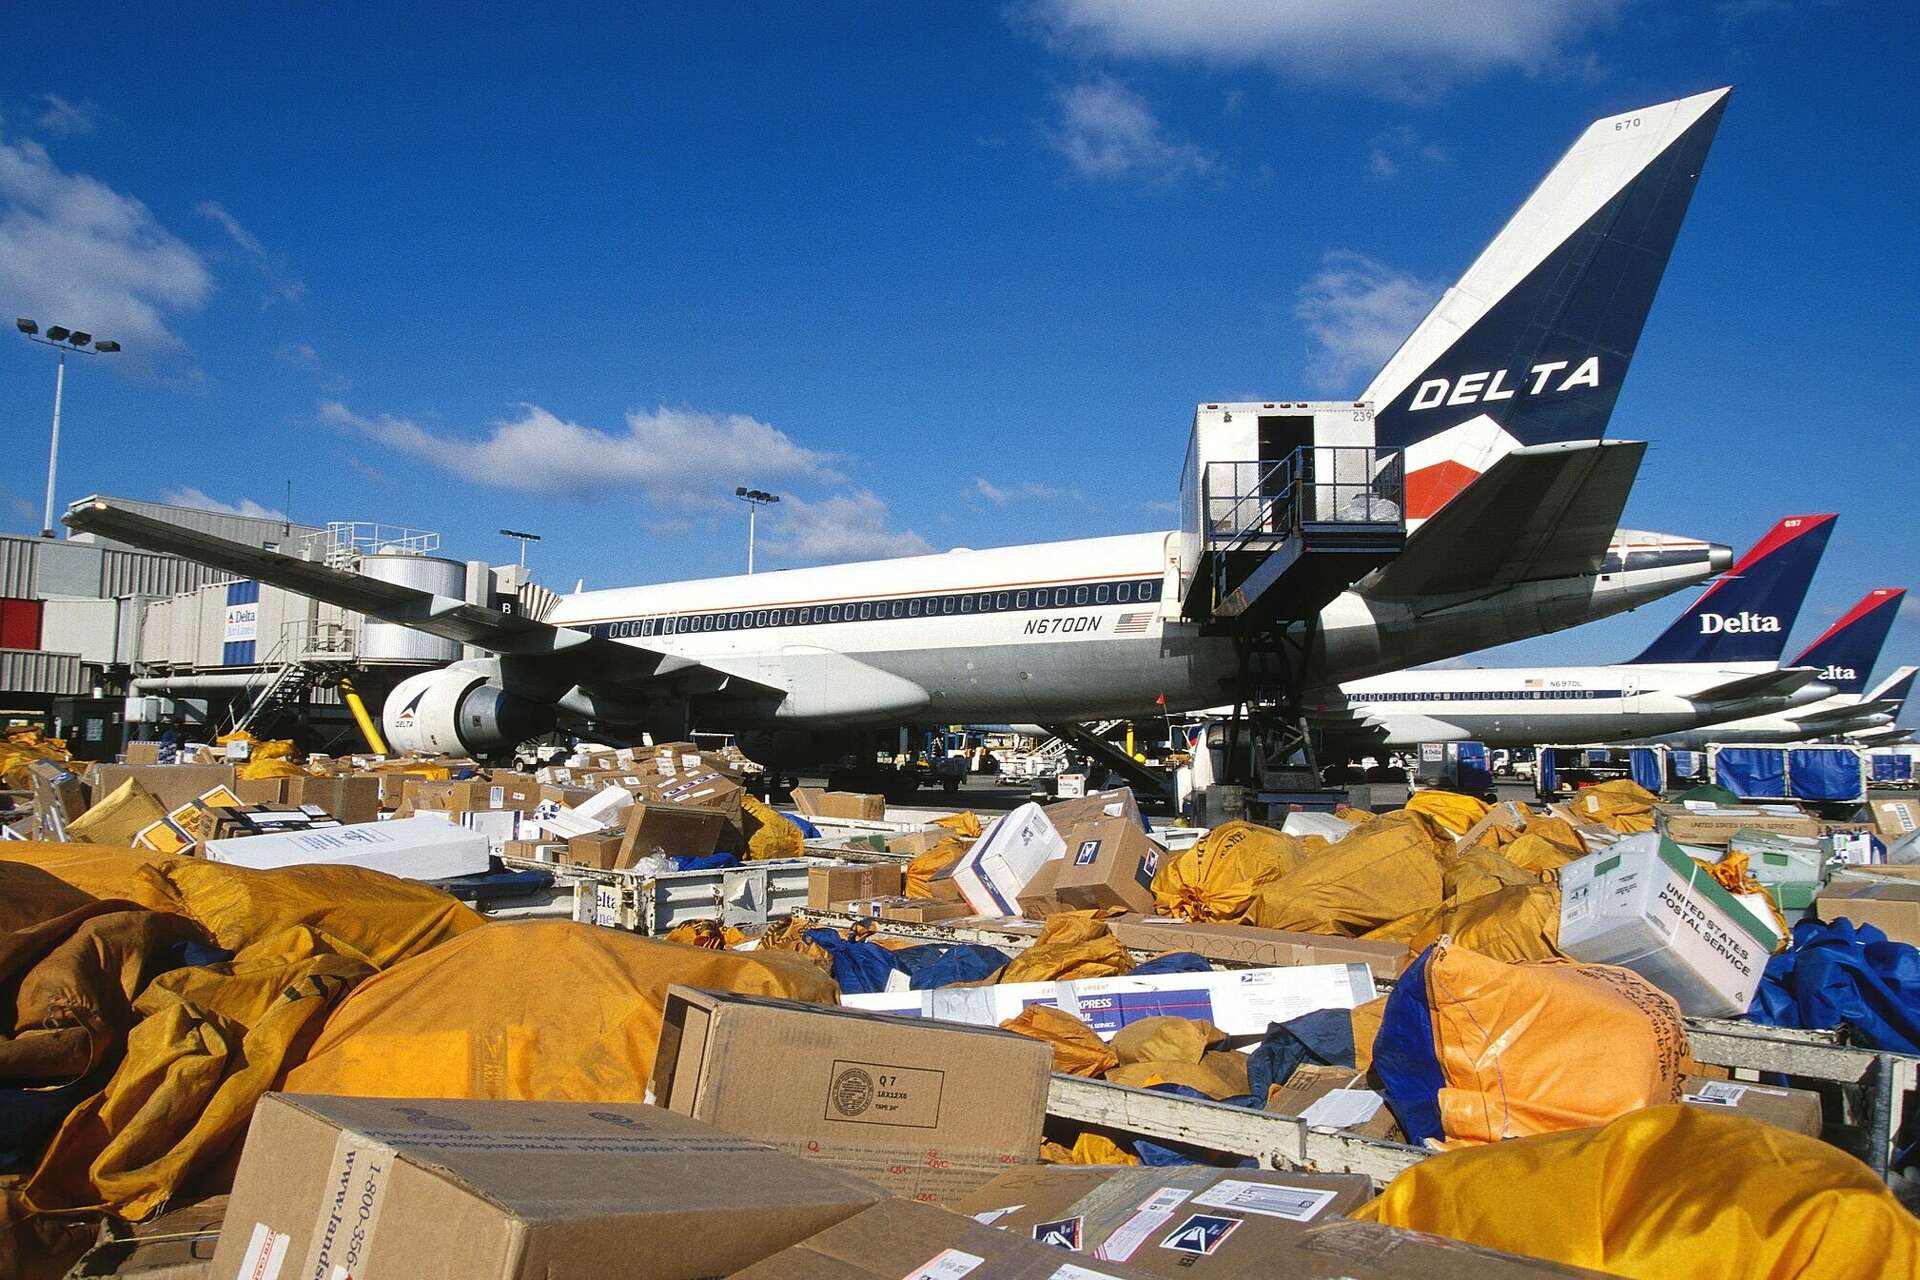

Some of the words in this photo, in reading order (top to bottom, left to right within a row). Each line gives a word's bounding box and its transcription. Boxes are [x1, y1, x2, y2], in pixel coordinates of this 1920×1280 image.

[1615, 118, 1641, 131] 670
[1408, 356, 1599, 412] DELTA
[1353, 411, 1372, 422] 239
[235, 609, 256, 623] Delta
[502, 603, 511, 614] B
[1024, 616, 1102, 635] N670DN
[1699, 611, 1781, 634] Delta
[1817, 665, 1856, 680] elta
[597, 891, 616, 909] elta
[1665, 882, 1706, 921] UNITED
[1706, 919, 1749, 960] STATES
[1657, 891, 1701, 934] POSTAL
[1702, 931, 1751, 977] SERVICE
[879, 1075, 887, 1087] Q
[889, 1076, 897, 1086] 7
